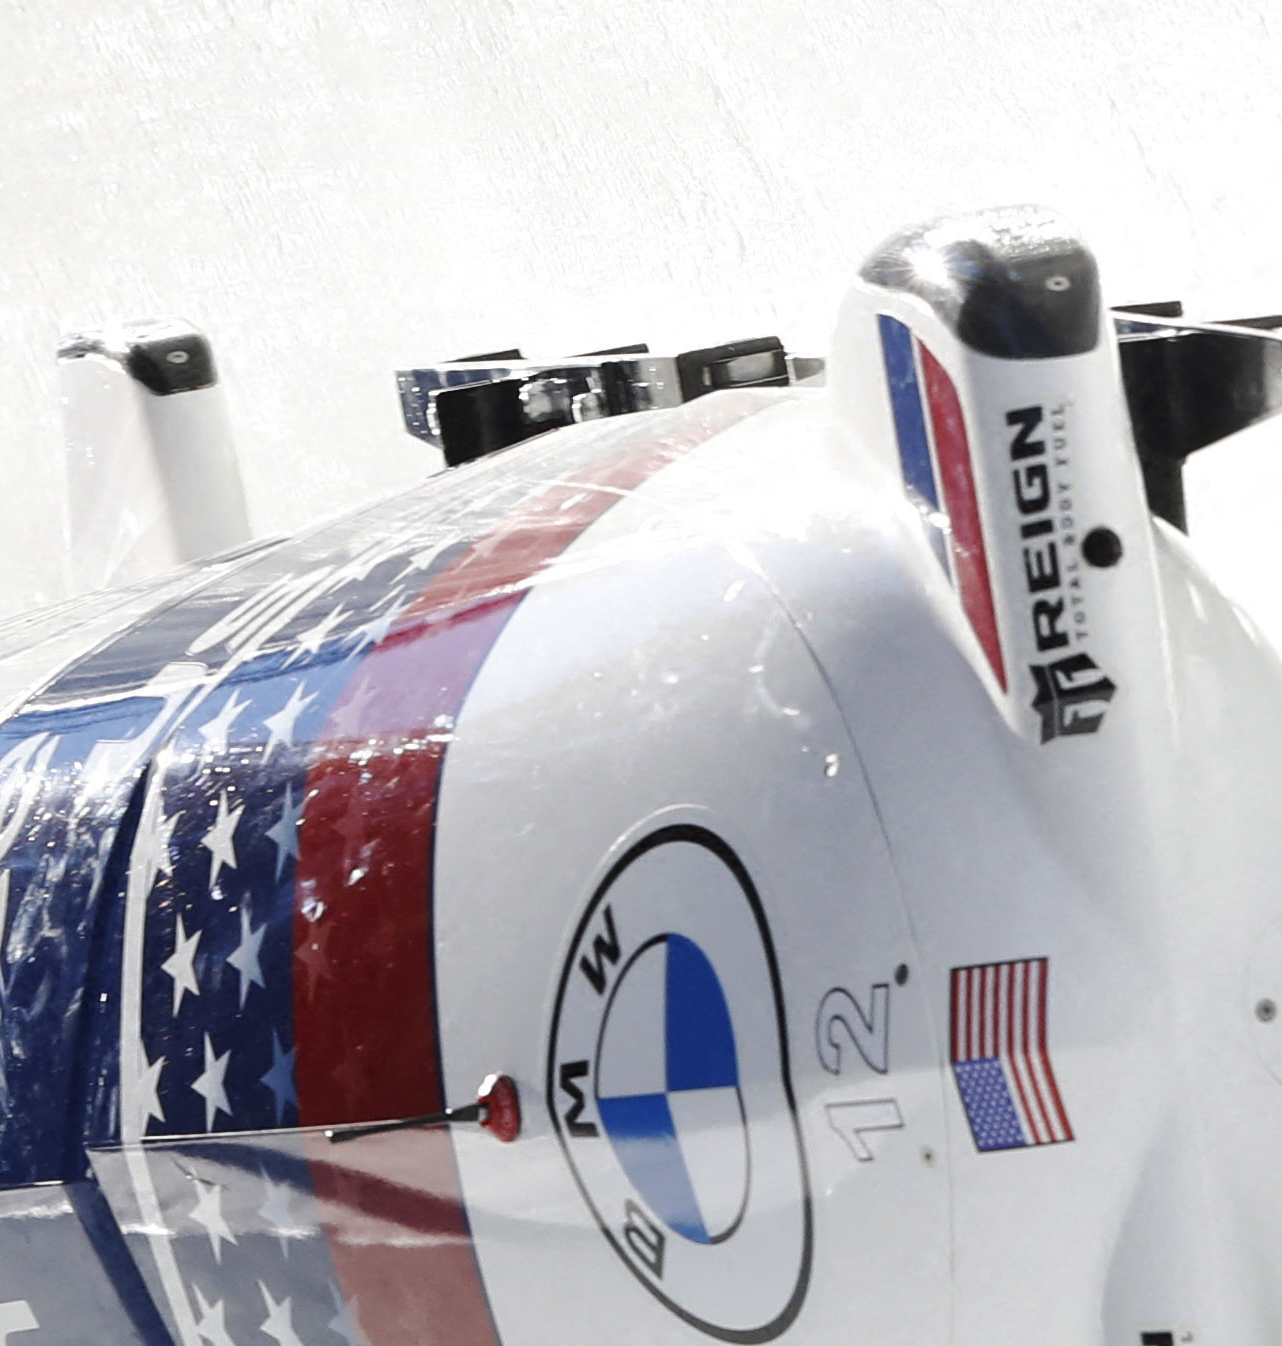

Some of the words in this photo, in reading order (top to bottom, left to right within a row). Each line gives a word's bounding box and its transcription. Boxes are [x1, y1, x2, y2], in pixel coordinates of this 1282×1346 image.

[1051, 405, 1068, 468] FUEL
[1006, 406, 1069, 651] REIGN
[1056, 482, 1076, 546] BODY
[1066, 561, 1089, 640] TOTAL
[816, 982, 905, 1163] 12
